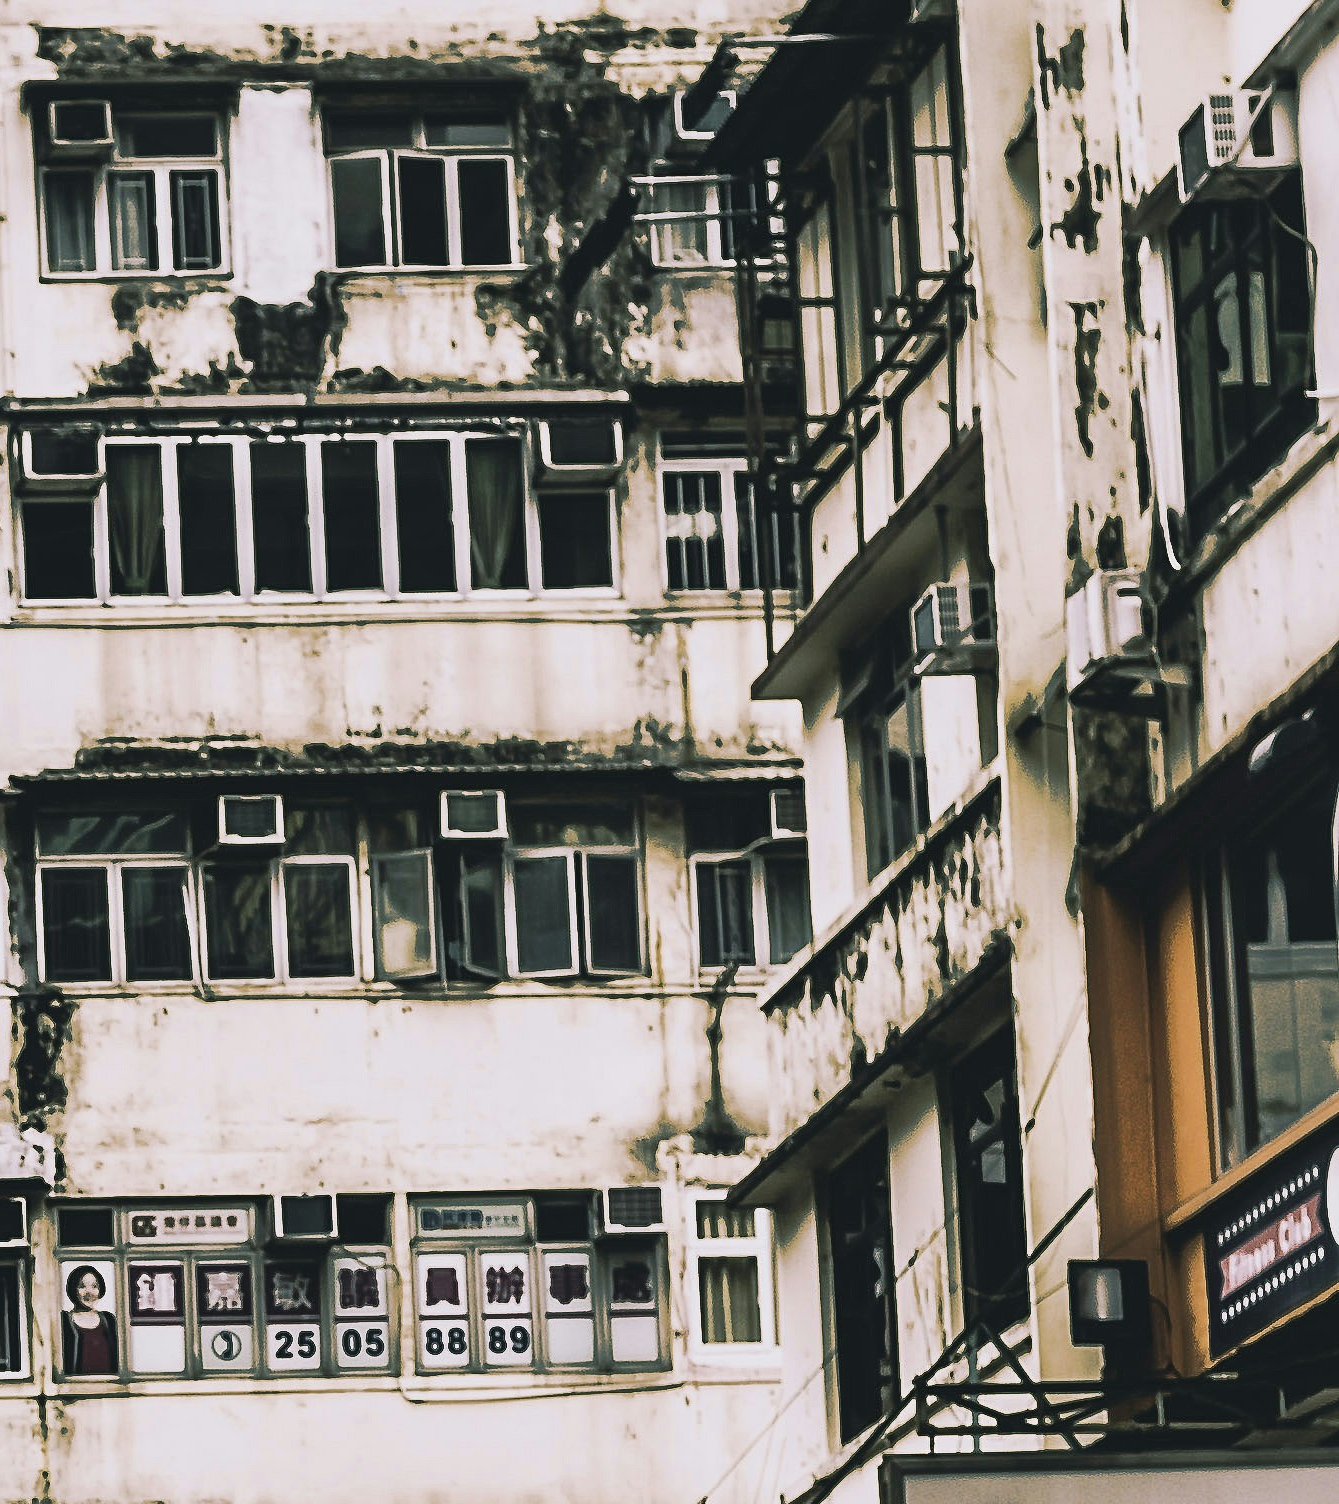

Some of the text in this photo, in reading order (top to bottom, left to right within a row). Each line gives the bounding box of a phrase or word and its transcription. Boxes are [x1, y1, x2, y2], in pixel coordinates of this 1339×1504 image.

[275, 1325, 531, 1359] 25 05 88 89
